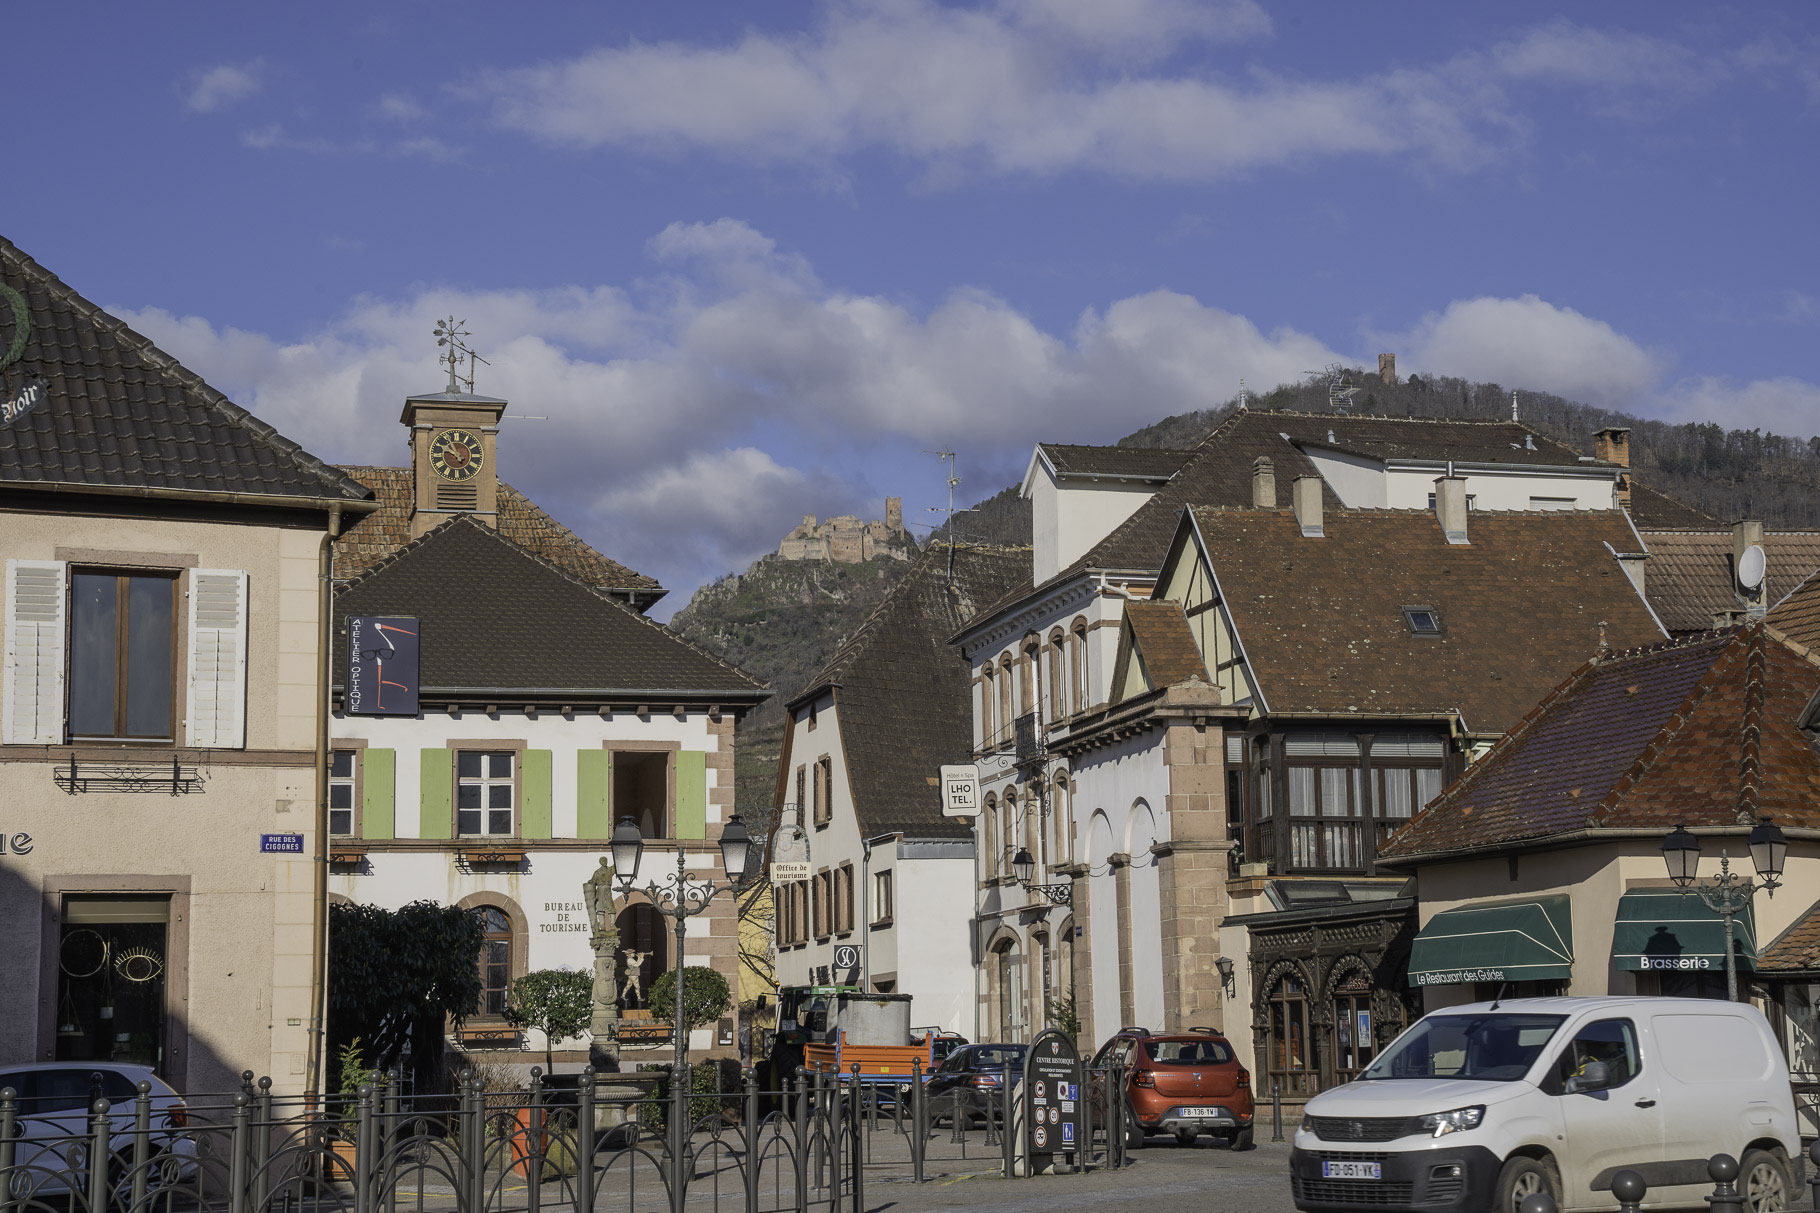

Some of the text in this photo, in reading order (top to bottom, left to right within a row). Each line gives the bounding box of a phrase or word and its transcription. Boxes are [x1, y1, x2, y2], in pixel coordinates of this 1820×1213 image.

[1, 385, 38, 422] Noir
[352, 619, 361, 663] ATELIER
[350, 666, 362, 712] OPTIQUE
[951, 784, 971, 793] LHO
[544, 902, 583, 911] BUREAU
[557, 913, 570, 921] DE
[540, 923, 588, 932] TOURISME
[1640, 956, 1710, 969] Brasserie
[1416, 968, 1505, 985] Le Restaurant des Guides
